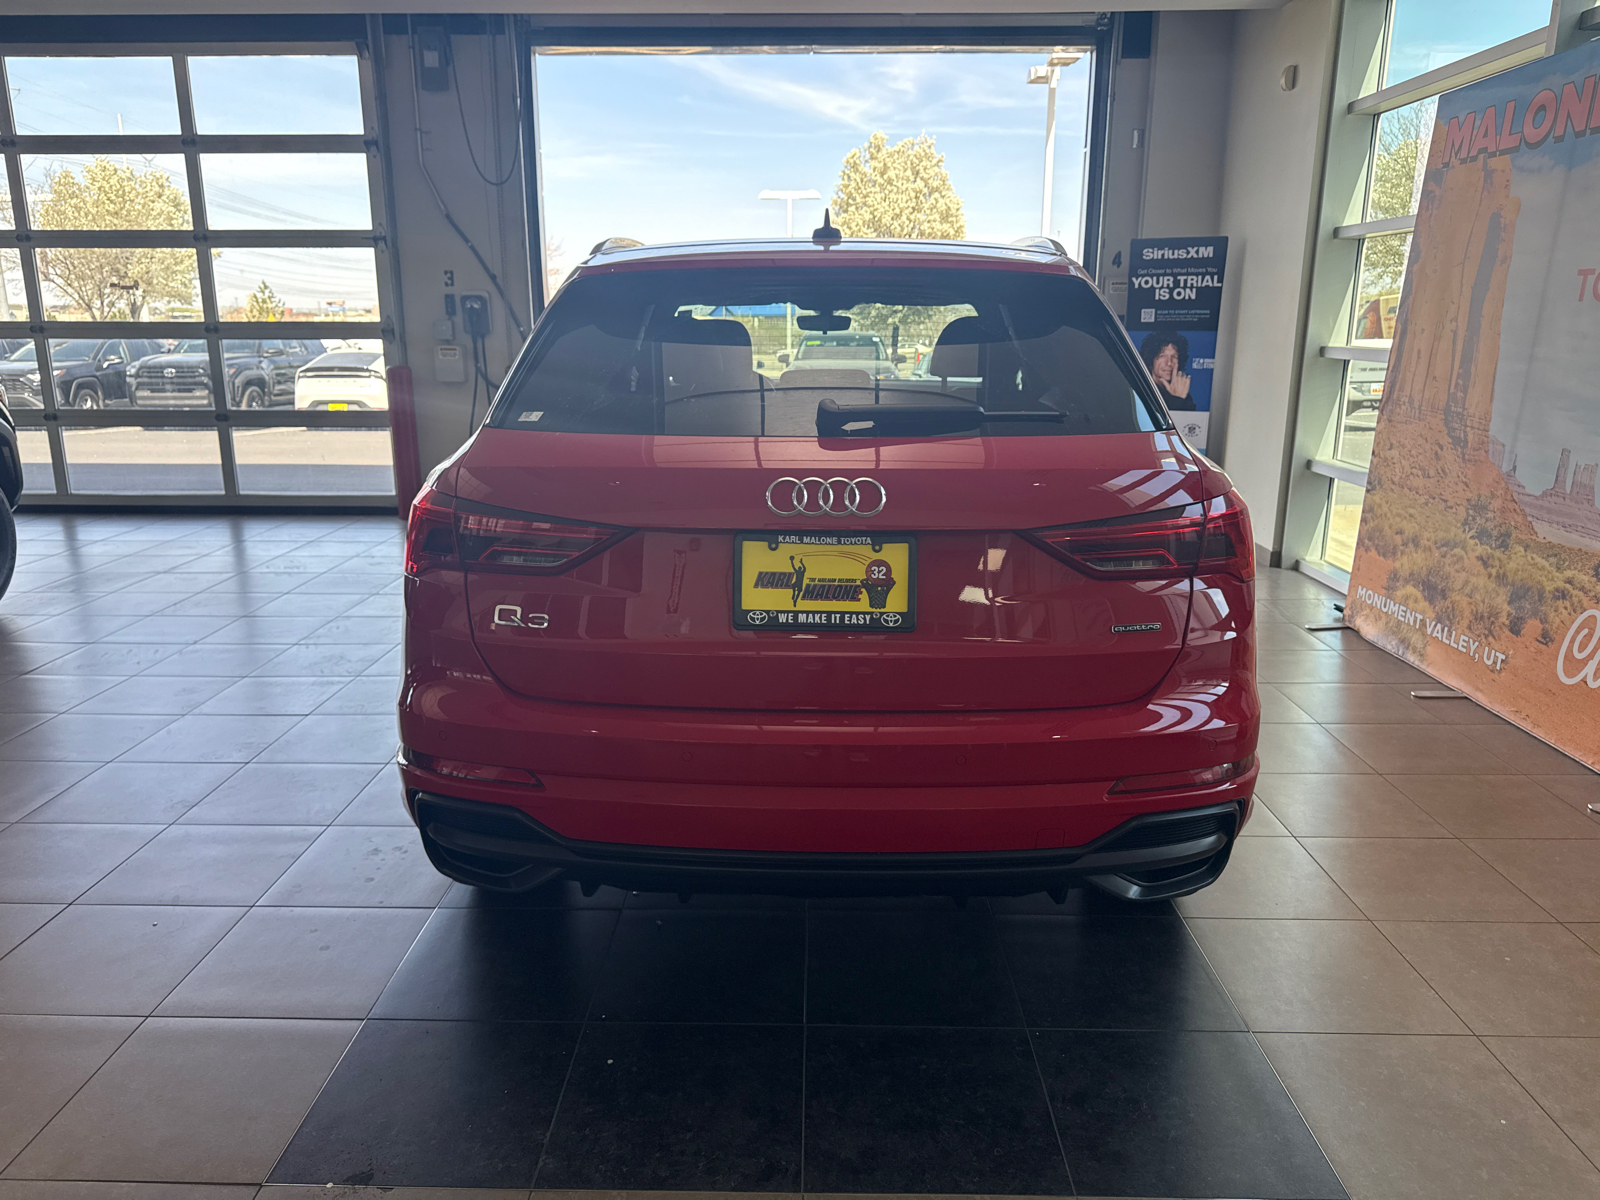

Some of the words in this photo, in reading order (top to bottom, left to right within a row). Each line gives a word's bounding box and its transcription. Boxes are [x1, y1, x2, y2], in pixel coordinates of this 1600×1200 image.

[1441, 73, 1600, 169] MALON
[1111, 250, 1122, 269] 4
[1142, 246, 1214, 260] SiriusXM
[444, 270, 454, 287] 3
[1131, 275, 1174, 289] YOUR
[1176, 274, 1222, 288] TRIAL
[1154, 288, 1170, 300] IS
[1172, 288, 1197, 300] ON
[778, 535, 801, 543] KARL
[803, 536, 838, 544] MALONE
[840, 537, 872, 545] TOYOTA
[753, 571, 796, 589] KARL
[870, 566, 886, 579] 32
[801, 583, 863, 602] MALONE
[494, 604, 549, 629] Q3
[778, 613, 794, 623] WE
[797, 613, 827, 624] MAKE
[831, 613, 840, 624] IT
[844, 614, 871, 624] EASY
[1114, 624, 1160, 632] quattro
[1356, 585, 1424, 630] MONUMENT
[1425, 618, 1480, 662] VALLEY,
[1482, 646, 1506, 671] UT
